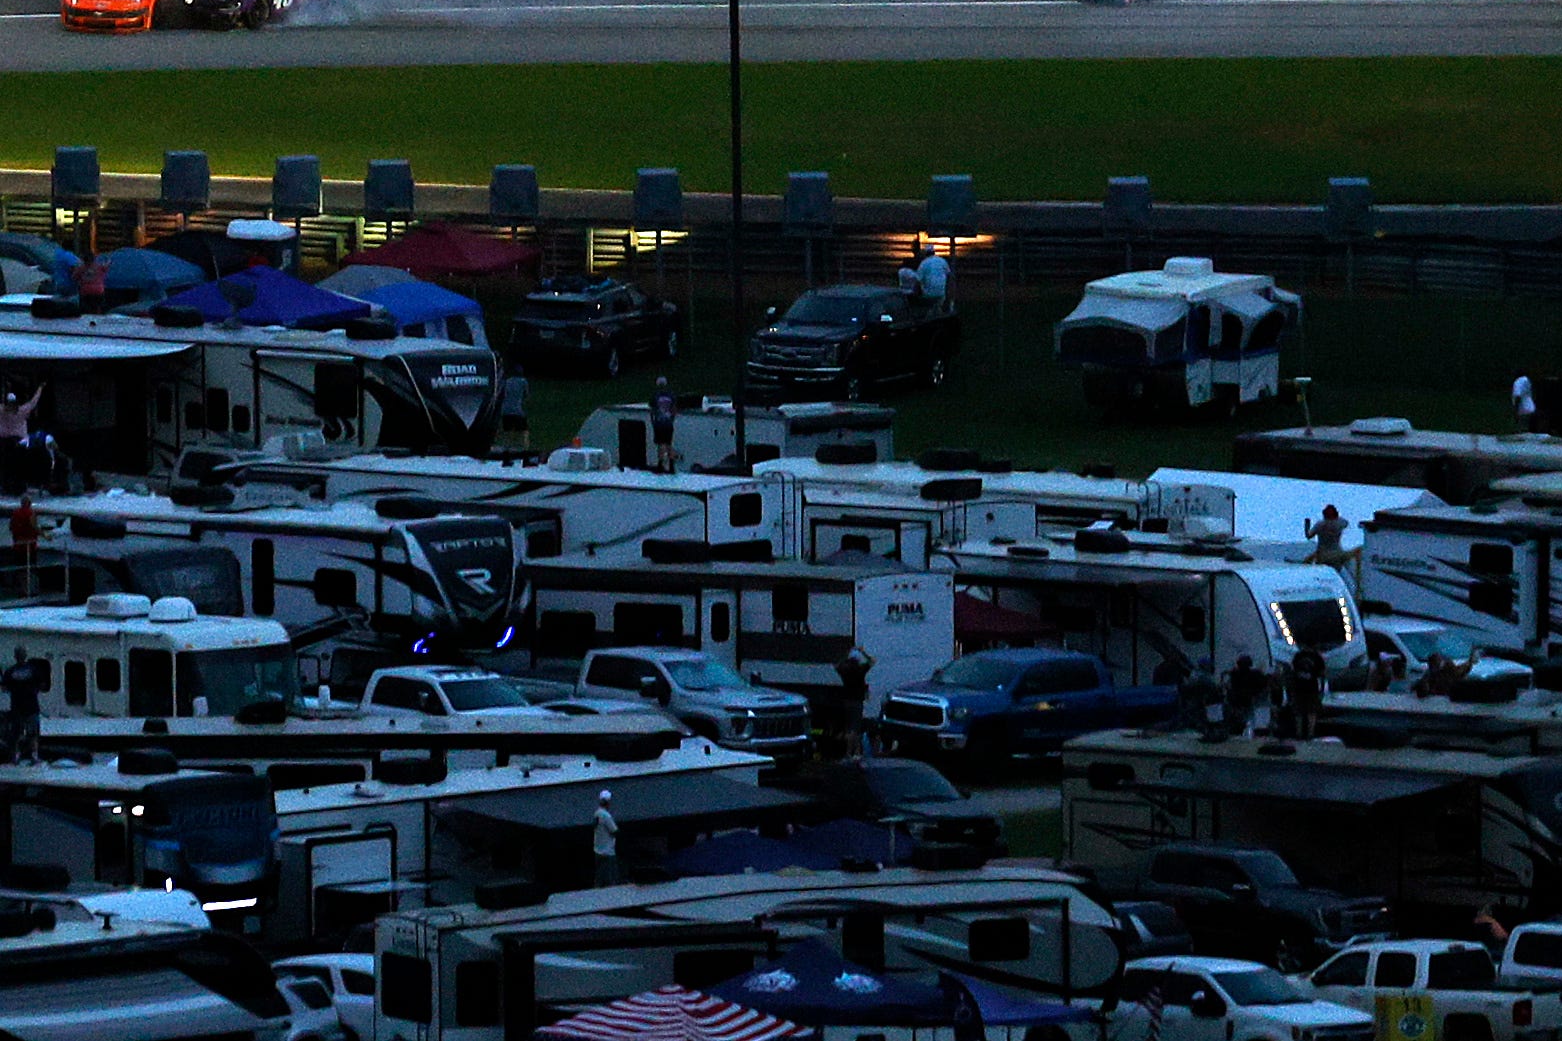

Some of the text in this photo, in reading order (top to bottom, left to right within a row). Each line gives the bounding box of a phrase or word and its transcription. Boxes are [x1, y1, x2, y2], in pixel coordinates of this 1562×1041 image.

[441, 363, 477, 376] ROAD
[456, 567, 497, 595] R
[887, 602, 924, 615] PUMA
